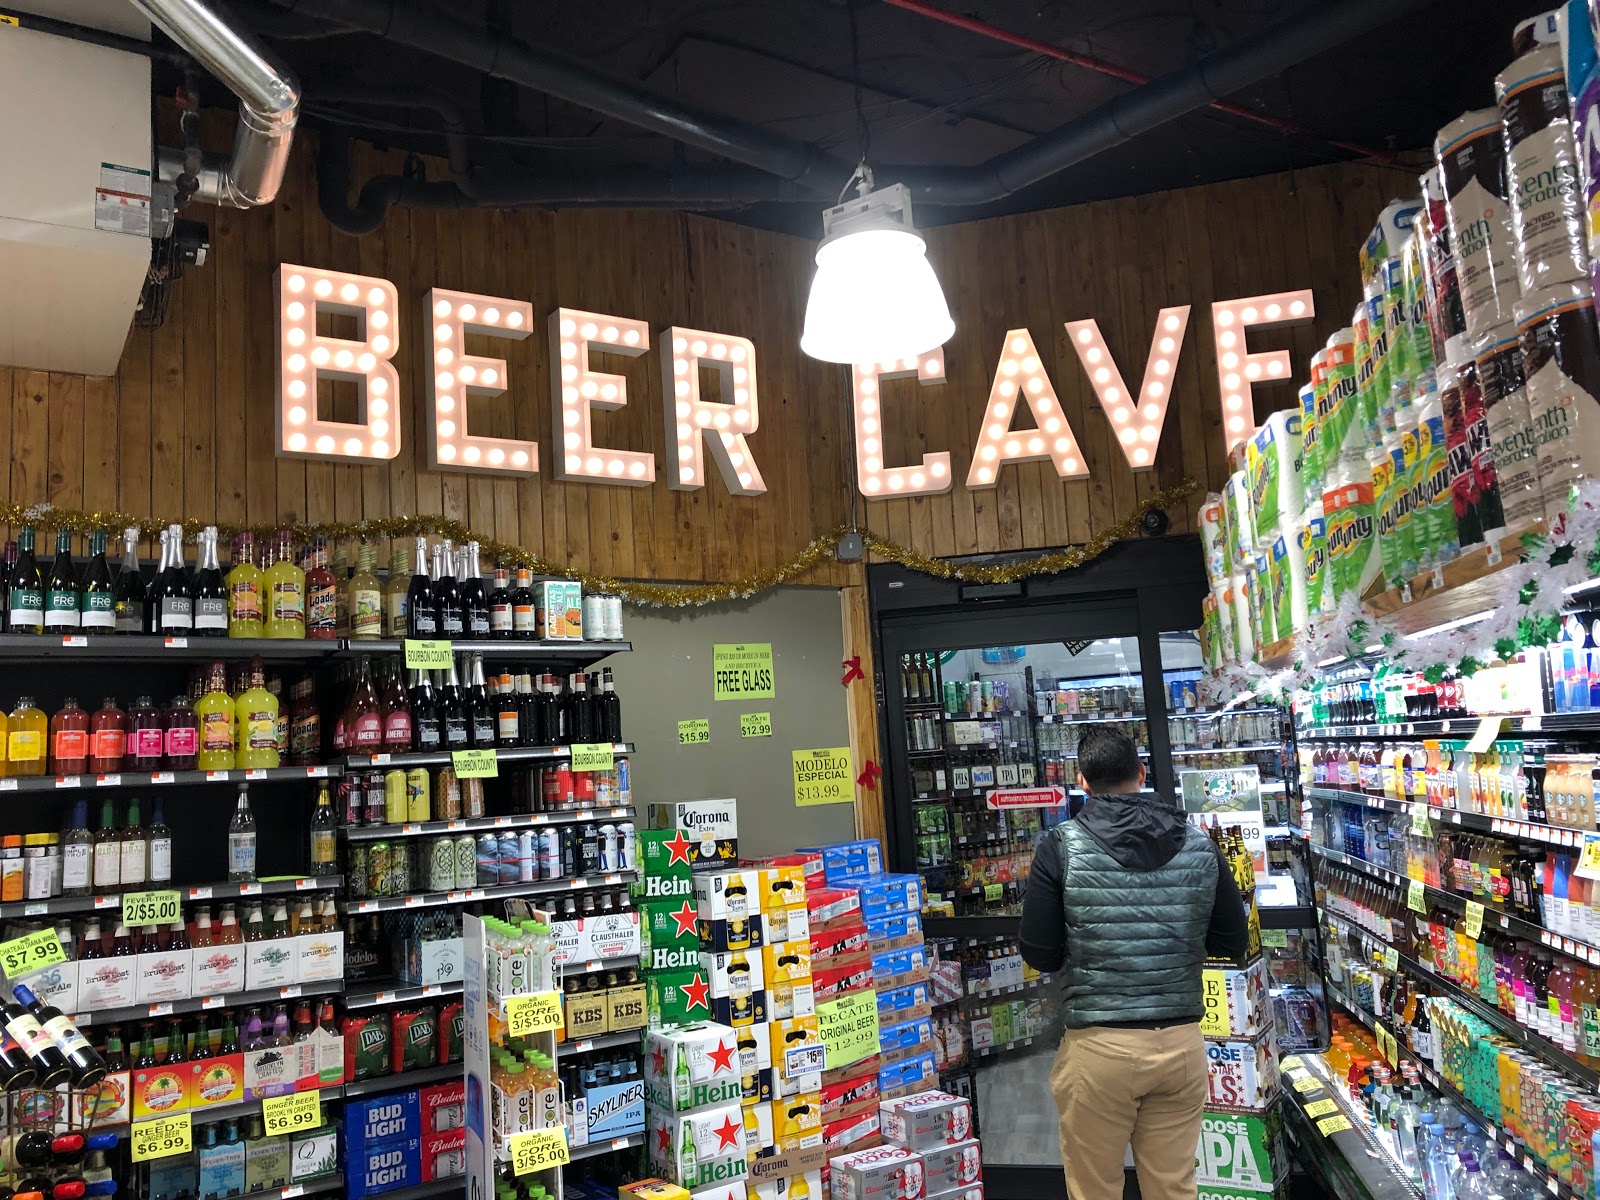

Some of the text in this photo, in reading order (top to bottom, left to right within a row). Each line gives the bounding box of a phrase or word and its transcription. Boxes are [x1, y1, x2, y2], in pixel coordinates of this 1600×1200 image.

[275, 262, 1315, 499] BEER CAVE
[566, 598, 581, 609] ALE
[408, 649, 451, 663] BOURBON COUNTY
[717, 669, 771, 692] FREE GLASS
[742, 715, 768, 723] TECATE
[679, 731, 709, 743] $15.99
[741, 724, 770, 736] $12.99
[455, 758, 496, 772] BOURBON COUNTY
[574, 751, 613, 765] BOURBON COUNTY
[795, 757, 848, 773] MODELO
[798, 770, 847, 782] ESPECIAL
[798, 784, 840, 802] $13.99
[683, 810, 729, 828] Corona
[647, 841, 656, 850] 12
[645, 875, 692, 897] Hein
[126, 895, 175, 904] FEVER-TREE
[126, 901, 176, 922] 2/$5.00
[24, 939, 43, 949] DIANA
[42, 933, 57, 944] WINE
[555, 937, 579, 947] THALER
[590, 931, 634, 943] CLAUSTHALER
[6, 942, 58, 969] $7.99
[253, 955, 274, 965] Bruce
[302, 949, 322, 958] Bruce
[652, 947, 699, 969] Hein
[8, 966, 33, 977] ASSORTED
[143, 968, 167, 978] Bruce
[199, 962, 221, 971] Bruce
[993, 964, 1006, 972] UFO
[85, 973, 110, 984] Bruce
[513, 1005, 557, 1019] CORE
[517, 999, 549, 1010] ORGANIC
[614, 1002, 643, 1018] KBS
[512, 1013, 560, 1030] 3/$5.00
[573, 1008, 603, 1025] KBS
[818, 1003, 874, 1025] TECATE
[413, 1023, 431, 1038] DAB
[819, 1015, 875, 1041] ORIGINAL BEER
[366, 1029, 383, 1045] DAB
[825, 1031, 873, 1055] $12.99
[1208, 1047, 1241, 1062] OSE
[255, 1061, 284, 1074] BROOKLYN
[257, 1068, 284, 1079] CRAFTED
[1211, 1063, 1235, 1075] STAR
[427, 1092, 465, 1107] Budwe
[692, 1080, 741, 1107] Hein
[266, 1096, 315, 1111] GINGER BEER
[266, 1103, 316, 1119] BROOKLYN CRAFTED
[587, 1084, 645, 1128] SKYLINER
[268, 1112, 313, 1130] $6.99
[368, 1104, 403, 1123] BUD
[625, 1111, 641, 1119] IPA
[134, 1121, 189, 1138] REED'S
[365, 1117, 407, 1139] LIGHT
[1202, 1119, 1248, 1134] OOSE
[142, 1130, 180, 1143] GINGER BEER
[520, 1135, 553, 1148] ORGANIC
[137, 1137, 184, 1155] $6.99
[251, 1146, 286, 1156] FEVER-TREE
[298, 1140, 316, 1160] Q
[428, 1137, 465, 1153] Budwe
[517, 1141, 562, 1157] CORE
[205, 1154, 241, 1165] FEVER-TREE
[295, 1162, 317, 1170] GINGER
[369, 1150, 403, 1171] BUD
[516, 1149, 565, 1170] 3/$5.00
[699, 1157, 748, 1185] Hein
[752, 1159, 788, 1177] Corona
[365, 1165, 407, 1187] LIGHT
